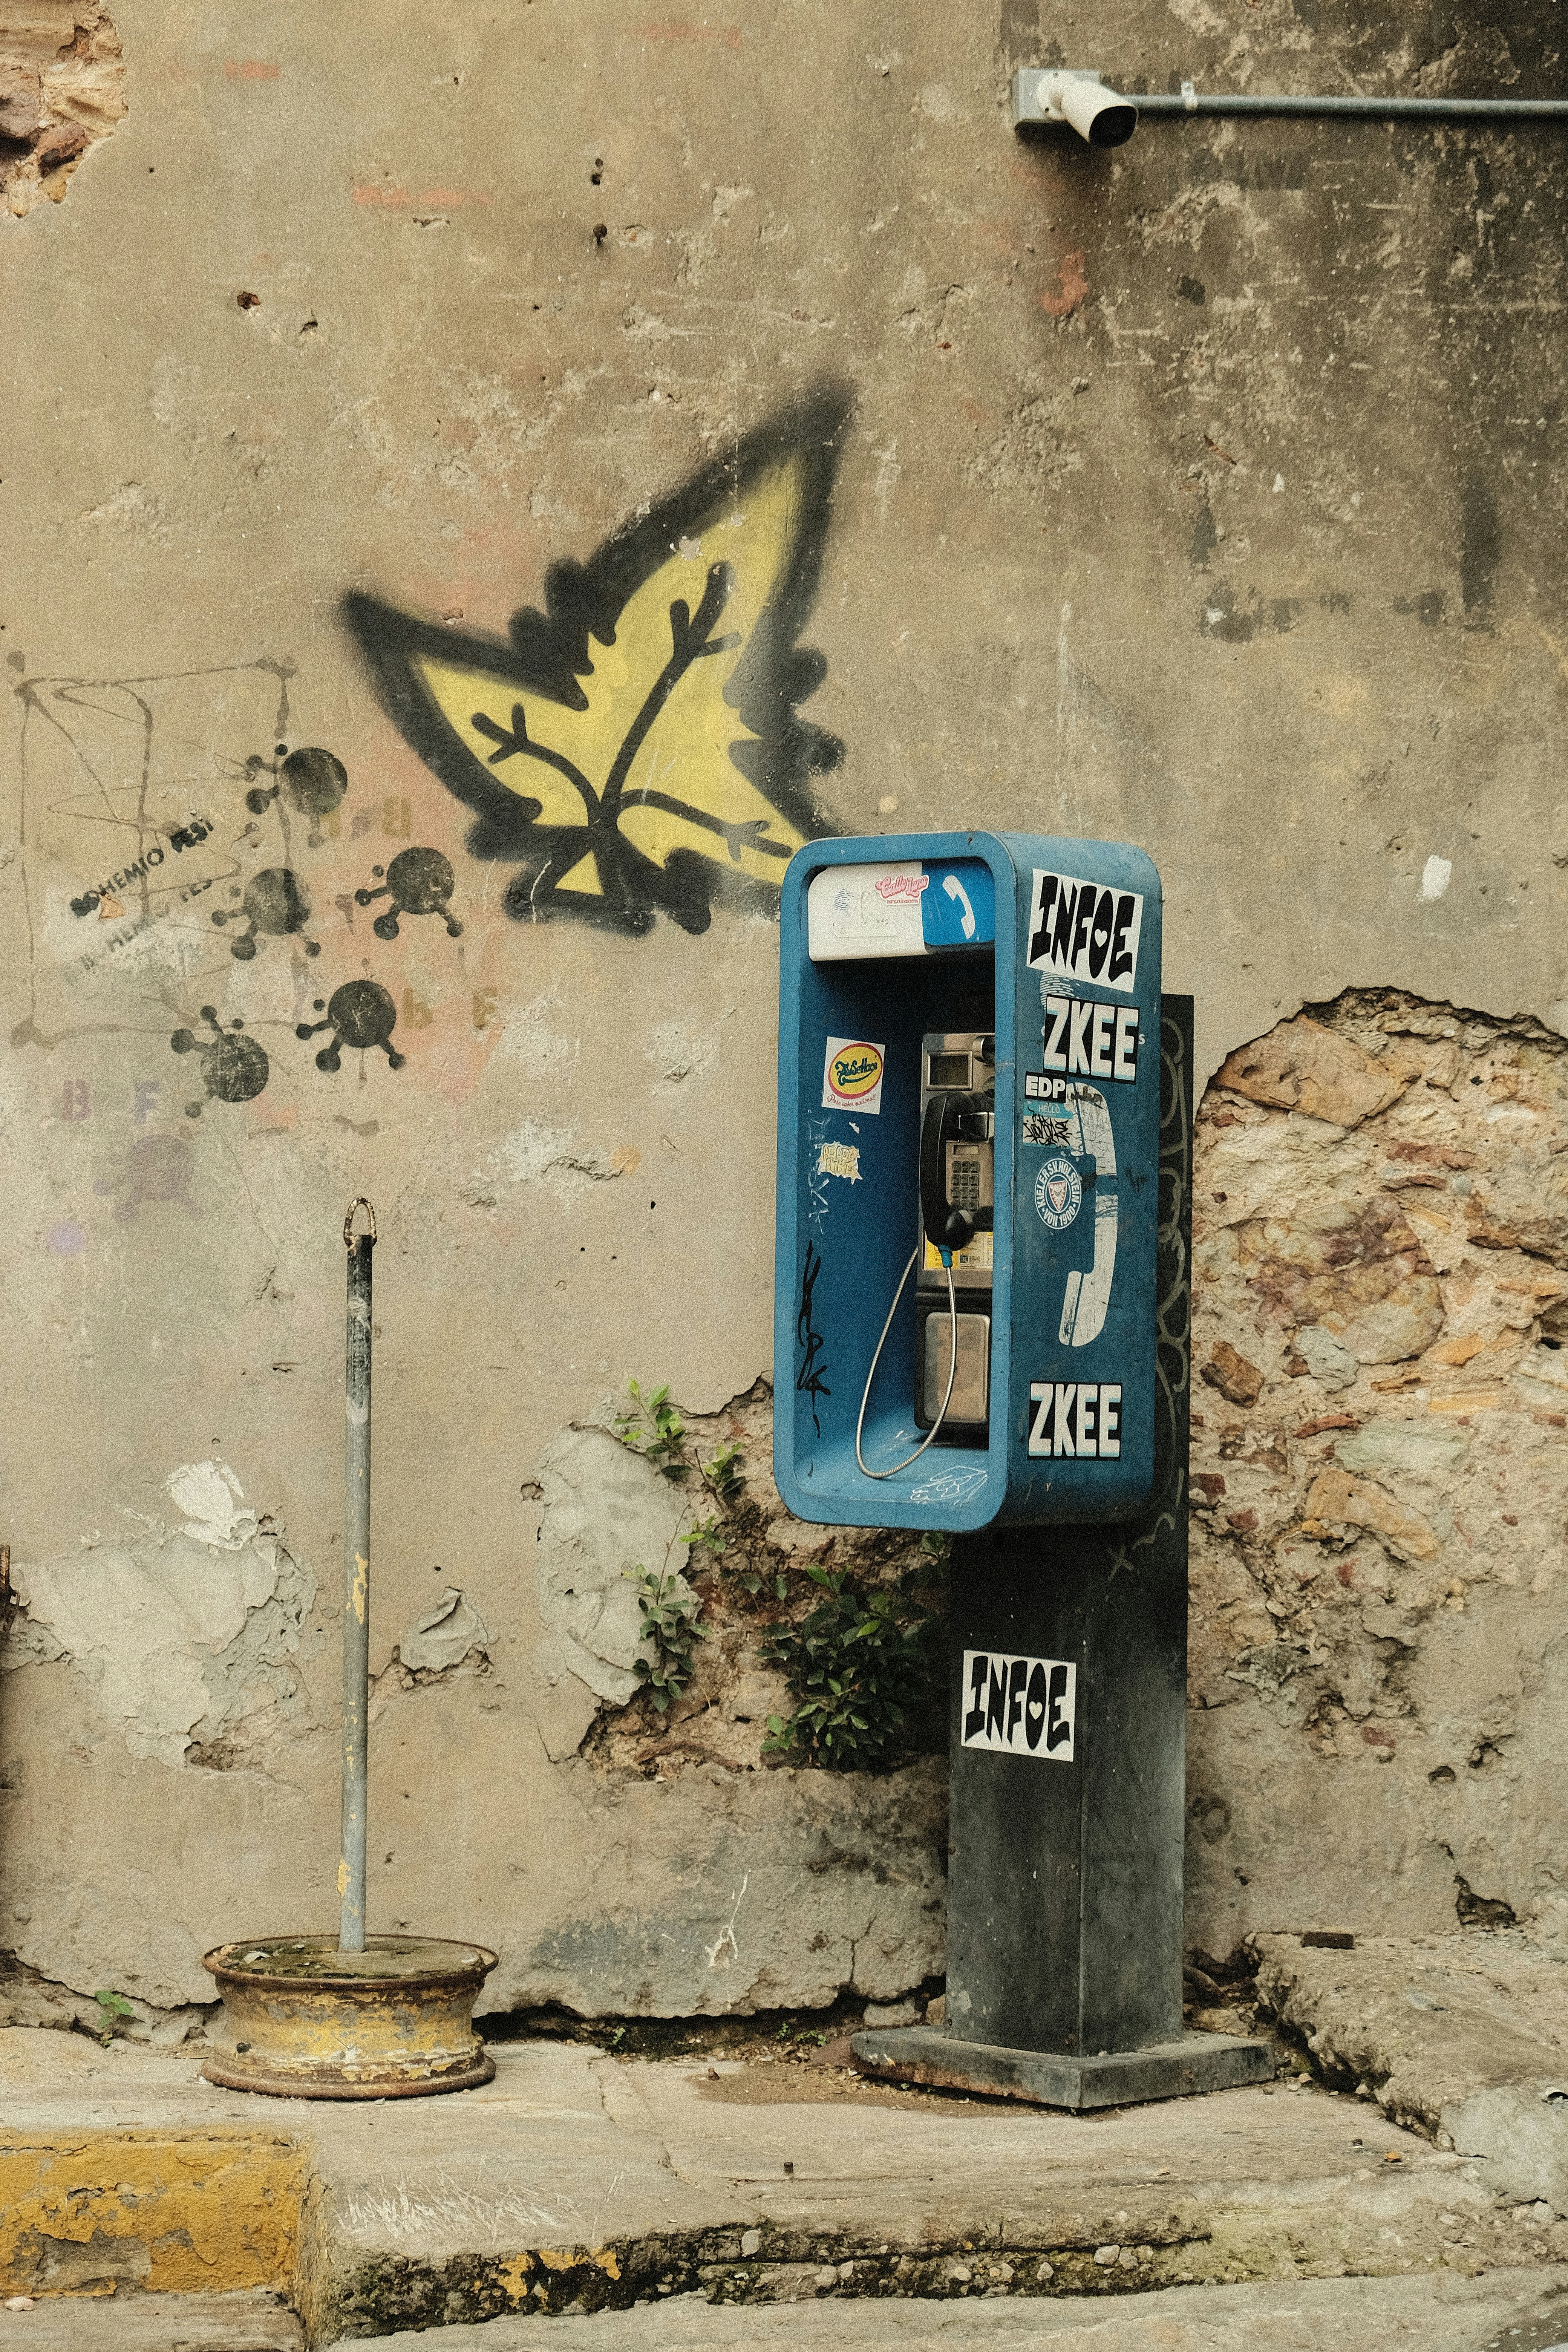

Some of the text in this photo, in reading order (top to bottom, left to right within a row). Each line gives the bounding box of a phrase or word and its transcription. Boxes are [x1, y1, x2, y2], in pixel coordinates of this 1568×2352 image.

[875, 875, 928, 899] Calle Luna
[1029, 875, 1135, 982] INFOE
[1044, 996, 1139, 1081] ZKEE
[1025, 1075, 1066, 1099] EDP
[1038, 1105, 1061, 1114] HELLO
[1036, 1169, 1050, 1208] KIELER
[1058, 1160, 1080, 1204] HOLSTEIN
[1044, 1205, 1076, 1227] VON 1900
[1028, 1383, 1122, 1457] ZKEE
[965, 1655, 1071, 1752] INFOE
